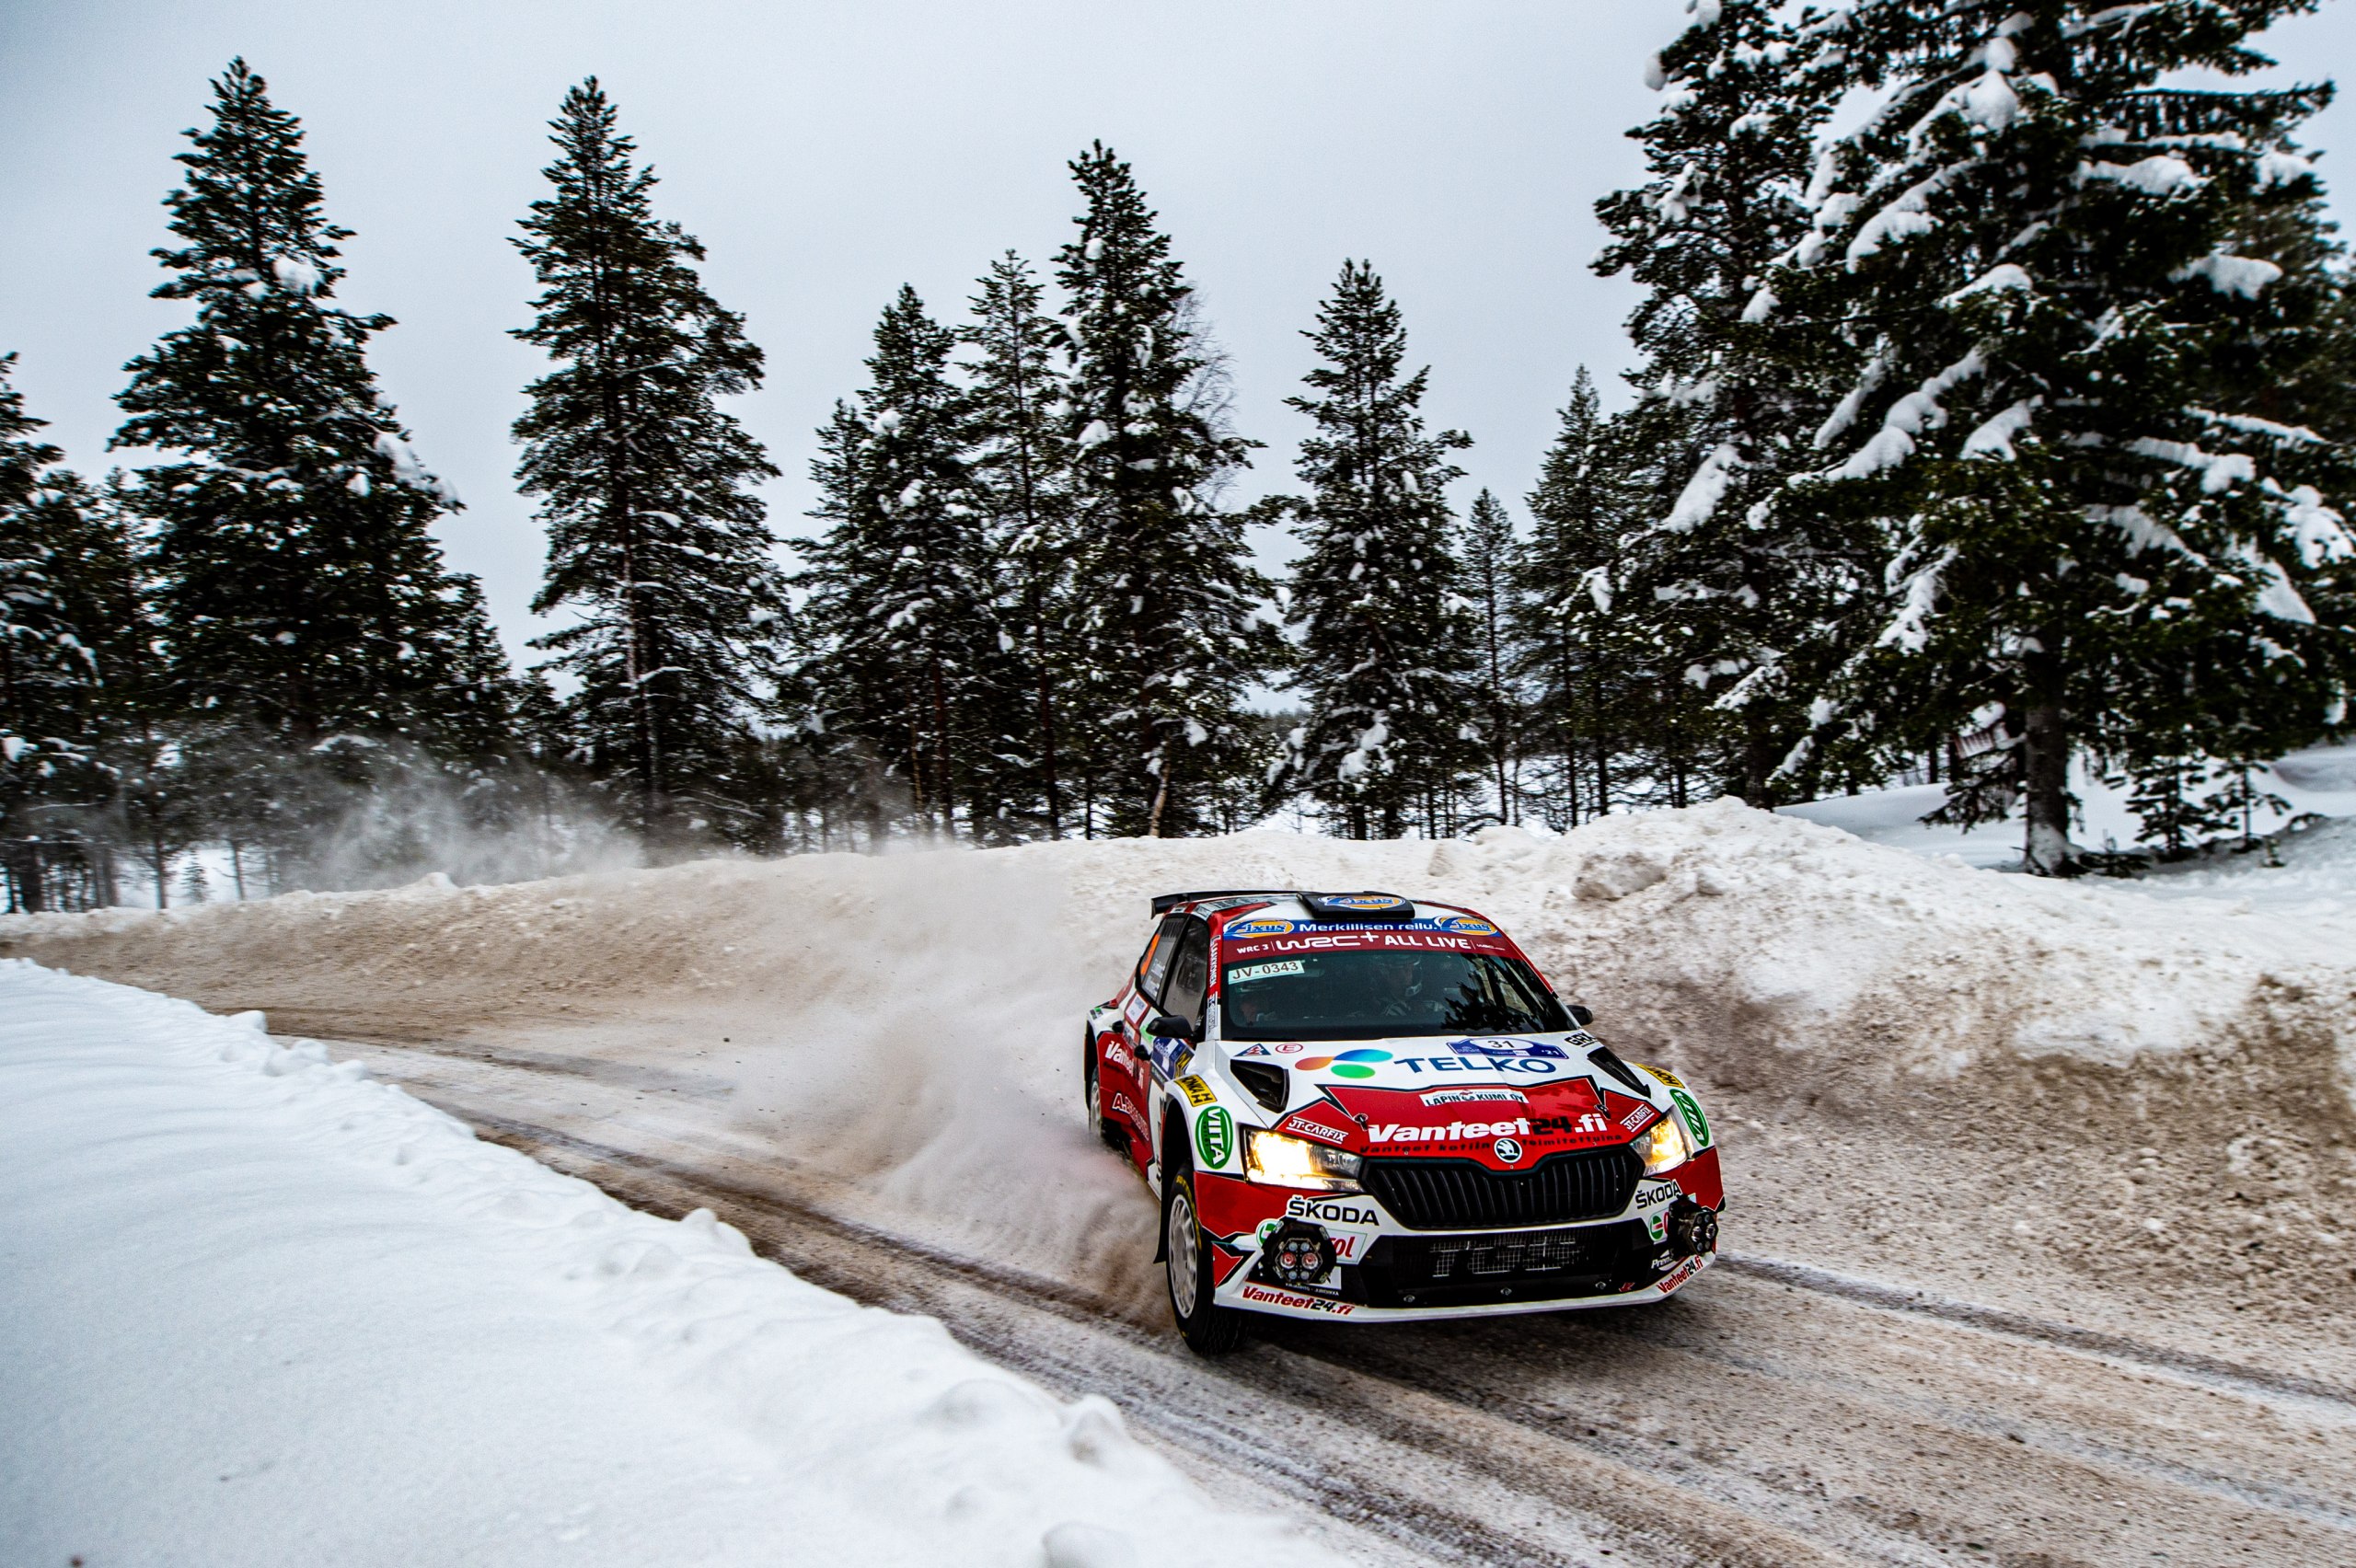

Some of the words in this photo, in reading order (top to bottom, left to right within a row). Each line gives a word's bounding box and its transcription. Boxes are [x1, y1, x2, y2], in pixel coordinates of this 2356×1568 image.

[1299, 923, 1393, 932] Merkillisen
[1236, 945, 1260, 954] WRC
[1262, 943, 1269, 951] 3
[1384, 934, 1423, 946] ALL
[1426, 936, 1472, 949] LIVE
[1232, 962, 1299, 980] JV-0343
[1487, 1040, 1515, 1049] 31
[1393, 1056, 1556, 1074] TELKO
[1425, 1095, 1461, 1106] LAPIN
[1368, 1113, 1608, 1143] Vanteet24.fi
[1635, 1181, 1681, 1210] ŠKODA
[1288, 1196, 1380, 1227] ŠKODA
[1657, 1254, 1703, 1294] Vanteet24.fi
[1242, 1286, 1355, 1316] Vanteet24.fi
